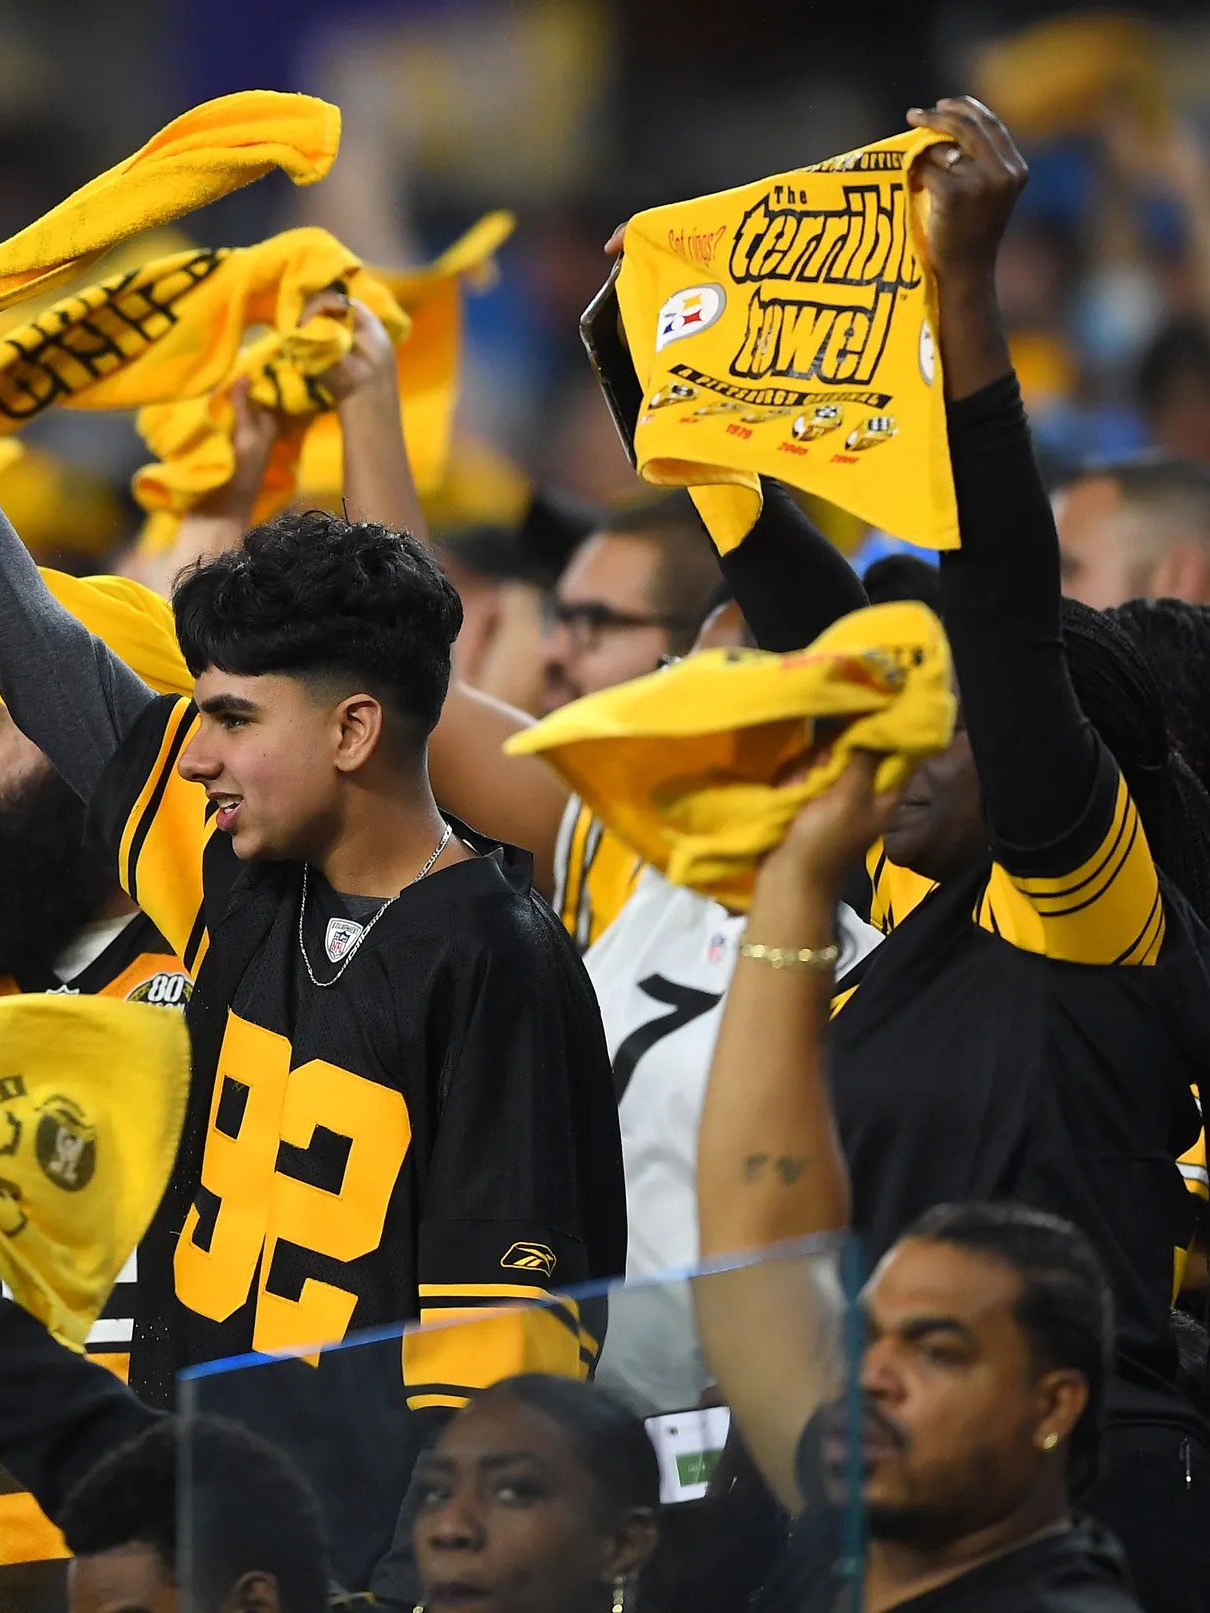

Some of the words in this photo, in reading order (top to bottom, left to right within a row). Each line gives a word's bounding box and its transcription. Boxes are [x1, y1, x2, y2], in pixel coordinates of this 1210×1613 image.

[860, 151, 905, 171] OFFIC
[773, 185, 808, 206] The
[728, 283, 898, 386] towel
[147, 973, 185, 1003] 80
[173, 1008, 412, 1369] 92
